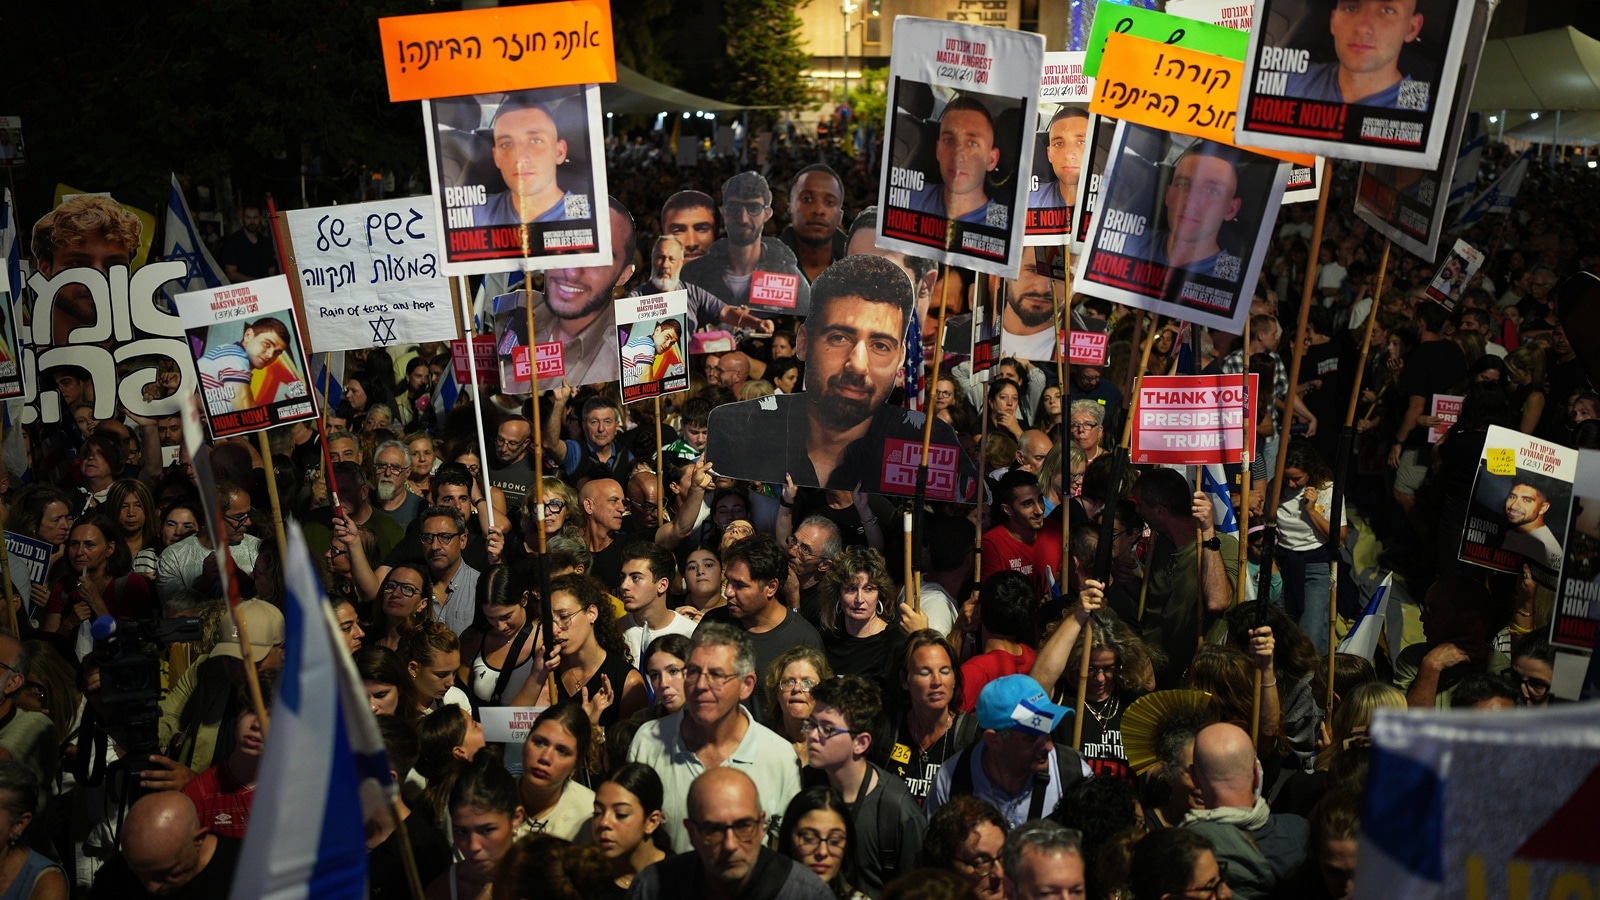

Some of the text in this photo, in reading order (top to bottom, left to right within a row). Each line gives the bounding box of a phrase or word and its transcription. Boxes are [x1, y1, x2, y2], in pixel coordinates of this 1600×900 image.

[397, 20, 600, 74] אתה חוזר הביתה!
[972, 43, 986, 56] מתן
[936, 50, 993, 70] MATAN ANGREST
[1259, 46, 1311, 74] BRING
[1060, 74, 1089, 85] ANGREST
[1153, 53, 1231, 94] קורה!
[1255, 70, 1289, 97] HIM
[1100, 79, 1180, 118] הביתה!
[1251, 96, 1348, 131] HOME NOW!
[1361, 125, 1423, 144] FAMILIES FORUM
[890, 166, 925, 191] BRING
[444, 184, 487, 207] BRING
[888, 186, 911, 209] HIM
[447, 206, 475, 229] HIM
[886, 208, 918, 234] HOME
[919, 214, 955, 239] NOW
[1040, 207, 1071, 227] NOW!
[1103, 208, 1147, 236] BRING
[316, 207, 426, 251] גשם של
[450, 229, 489, 252] HOME
[491, 225, 528, 249] NOW
[1097, 229, 1127, 254] HIM
[301, 261, 356, 293] ותקווה
[765, 274, 795, 286] עדיין
[1091, 251, 1173, 290] HOME NOW!
[210, 294, 259, 311] MAKSYM HARKIN
[756, 289, 794, 300] בעזה.
[1181, 287, 1232, 310] FAMILIES FORUM
[319, 306, 344, 318] Rain
[362, 303, 389, 313] tears
[412, 300, 436, 312] hope
[1072, 334, 1104, 345] עדיין
[623, 366, 643, 378] BRING
[623, 377, 636, 388] HIM
[624, 386, 641, 397] HOME
[641, 382, 660, 394] NOW!
[204, 385, 235, 404] BRING
[1143, 391, 1207, 405] THANK
[1211, 389, 1244, 403] YOU
[208, 400, 230, 416] HIM
[212, 412, 241, 431] HOME
[242, 406, 269, 425] NOW!
[1143, 411, 1243, 426] PRESIDENT
[1162, 433, 1227, 448] TRUMP
[1519, 447, 1562, 467] EVYATAR DAVID
[1522, 458, 1541, 470] (23)
[1469, 517, 1499, 535] BRING
[1466, 528, 1487, 545] HIM
[35, 546, 47, 561] עד
[1464, 541, 1492, 559] HOME
[1564, 577, 1600, 601] BRIN
[1561, 597, 1590, 618] HIM
[1559, 617, 1598, 639] HOME
[508, 721, 532, 730] MAKSYM
[1084, 742, 1112, 759] הביתה
